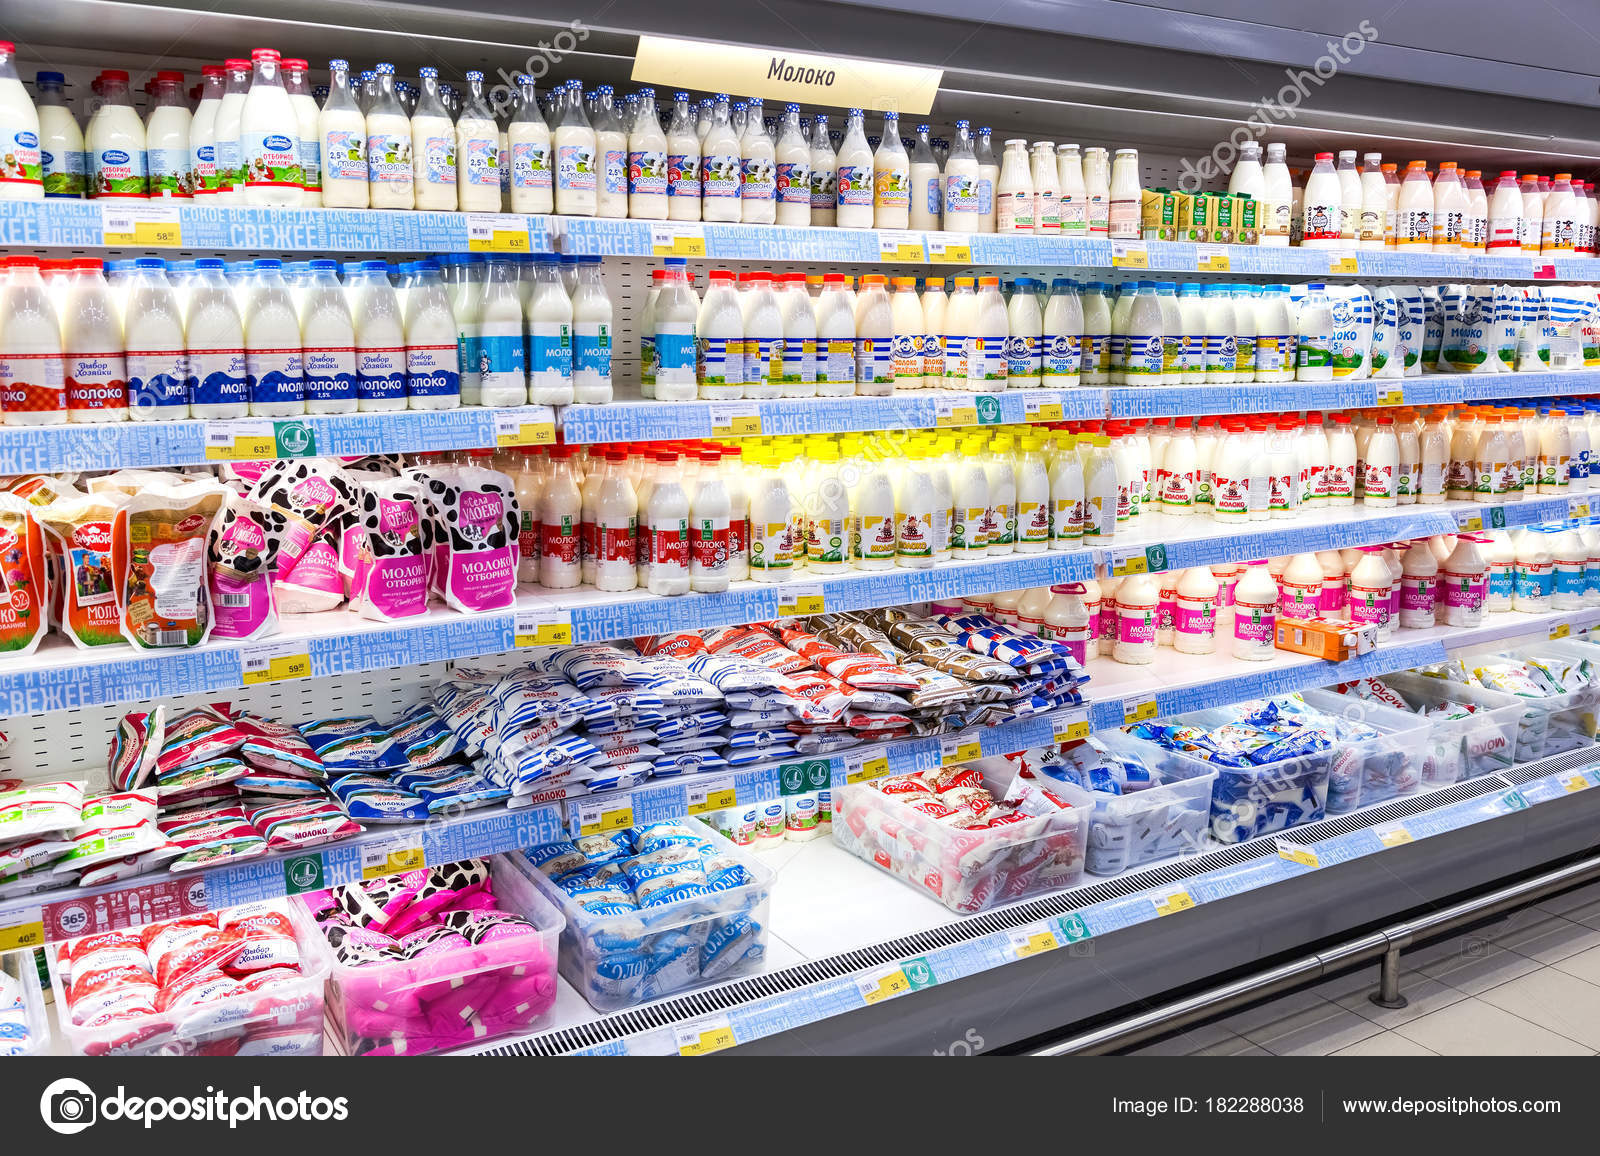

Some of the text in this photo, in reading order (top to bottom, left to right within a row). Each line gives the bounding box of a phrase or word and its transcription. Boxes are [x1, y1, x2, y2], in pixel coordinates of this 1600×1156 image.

[767, 57, 836, 86] Молоко
[228, 209, 315, 225] ВСЕ ВСЕГДА
[326, 212, 377, 224] КАЧЕСТВО
[595, 221, 631, 234] ВСЕГДА
[229, 223, 317, 248] СВЕЖЕЕ
[329, 234, 379, 249] ДЕНЬГИ
[568, 235, 633, 254] СВЕЖЕЕ
[760, 240, 819, 259] СВЕЖЕЕ
[309, 354, 335, 363] Выбор
[363, 354, 389, 363] Выбор
[408, 360, 436, 368] Хозяйки
[409, 352, 433, 362] Выбор
[78, 360, 107, 370] Выбор
[307, 362, 339, 371] Хозяйки
[361, 362, 393, 370] Хозяйки
[75, 368, 112, 378] Хозяйки
[304, 380, 349, 391] МОЛОКО
[356, 380, 402, 390] МОЛОКО
[70, 389, 122, 399] МОЛОКО
[1110, 399, 1152, 417] СВЕЖЕЕ
[1231, 397, 1269, 412] СВЕЖЕЕ
[421, 413, 476, 427] ВЫСОКОЕ
[594, 407, 629, 419] ВСЕГДА
[331, 417, 380, 429] КАЧЕСТВО
[564, 420, 630, 444] СВЕЖЕЕ
[639, 426, 678, 440] ДЕНЬГИ
[254, 446, 265, 454] 63
[334, 438, 383, 454] ДЕНЬГИ
[462, 558, 511, 574] МОЛОКО
[466, 569, 511, 581] ОТБОРНОЕ
[870, 574, 907, 588] ВЫСОКОЕ
[1449, 591, 1481, 600] МОЛОКО
[1284, 601, 1316, 611] МОЛОКО
[1354, 606, 1387, 615] МОЛОКО
[586, 608, 621, 620] ВСЕГДА
[447, 619, 500, 637] ВЫСОКОЕ
[632, 615, 670, 632] ДЕНЬГИ
[360, 630, 408, 645] КАЧЕСТВО
[102, 659, 159, 676] КАЧЕСТВО
[363, 651, 410, 670] ДЕНЬГИ
[288, 664, 298, 672] 59
[39, 669, 89, 685] ВСЕГДА
[104, 683, 160, 702] ДЕНЬГИ
[524, 720, 559, 743] МОЛОКО
[532, 788, 567, 803] МОЛОКО
[643, 805, 684, 822] ДЕНЬГИ
[463, 815, 534, 837] ВЫСОКОЕ ВСЕ
[108, 831, 135, 841] МОЛОКО
[294, 828, 328, 840] МОЛОКО
[62, 912, 85, 927] 365
[18, 935, 29, 944] 40
[87, 933, 142, 948] МОЛОКО
[239, 951, 274, 965] Хозяйки
[244, 946, 270, 957] Выбор
[86, 966, 142, 986] МОЛОКО
[891, 982, 900, 991] 32
[271, 1042, 302, 1051] Выбор
